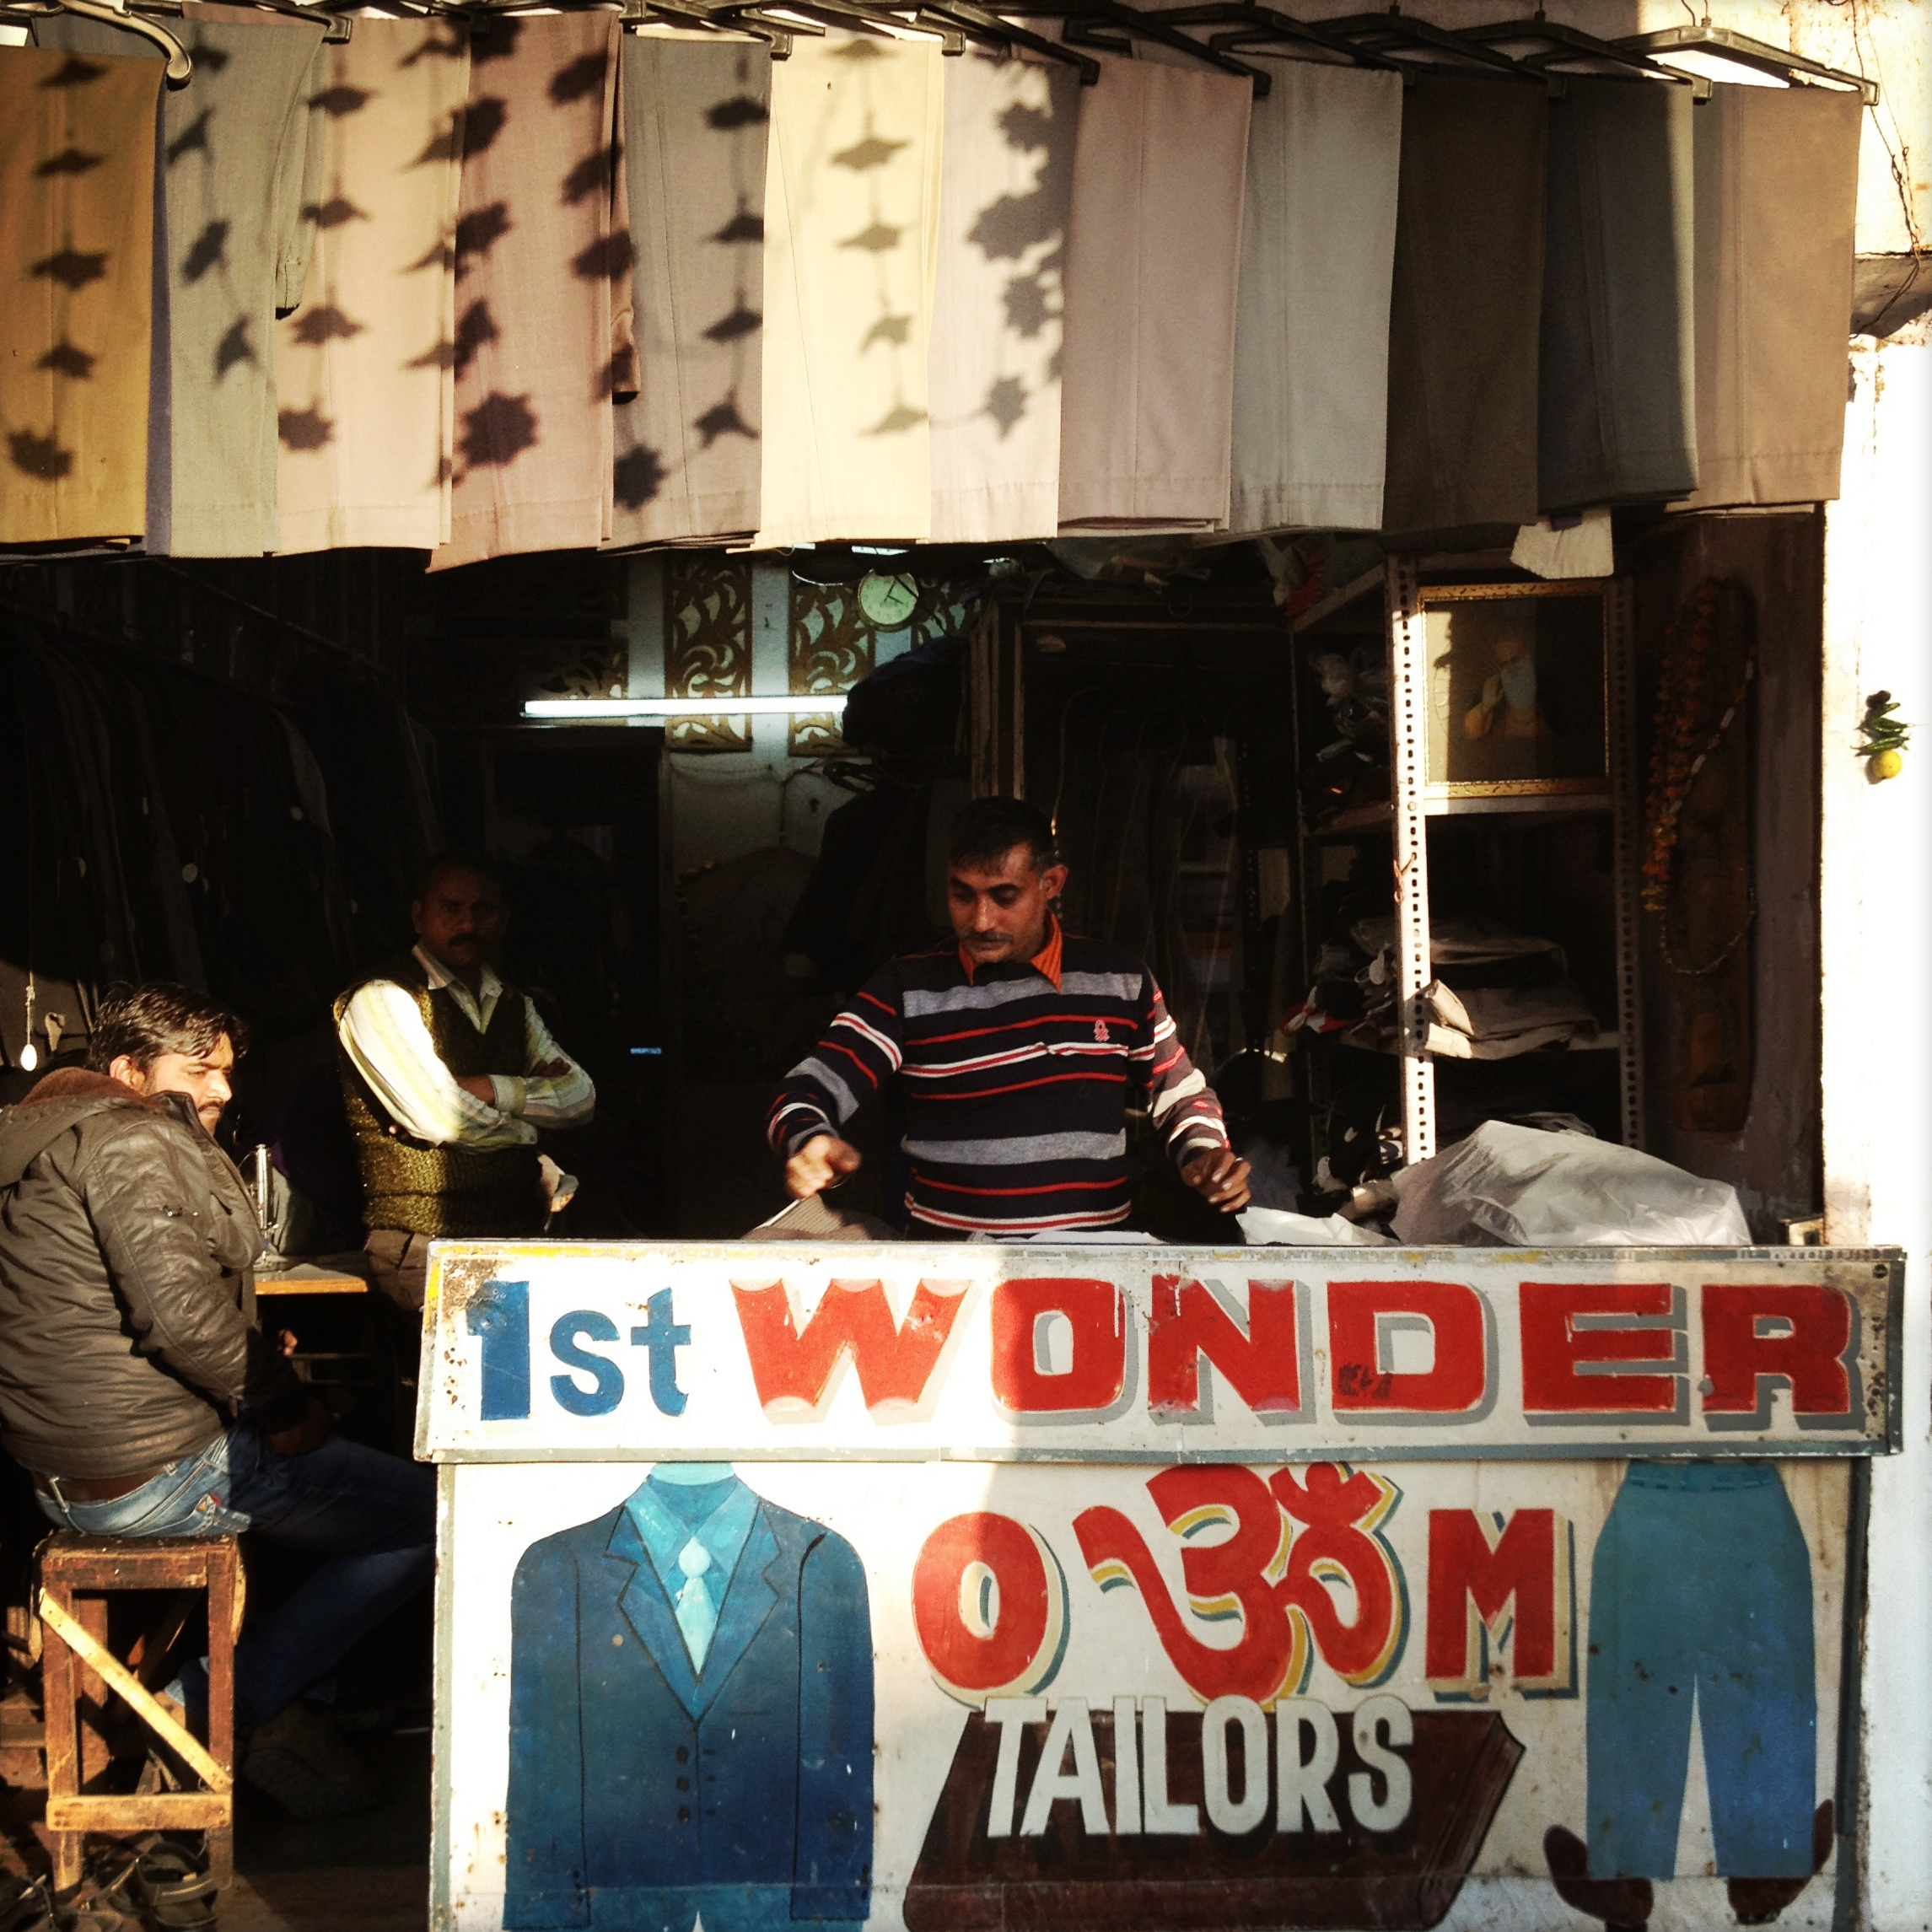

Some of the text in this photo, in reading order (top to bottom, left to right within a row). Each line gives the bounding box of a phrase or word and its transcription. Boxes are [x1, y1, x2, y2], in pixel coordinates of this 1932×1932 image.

[467, 1277, 1867, 1432] 1st WONDER
[985, 1694, 1414, 1837] TAILORS
